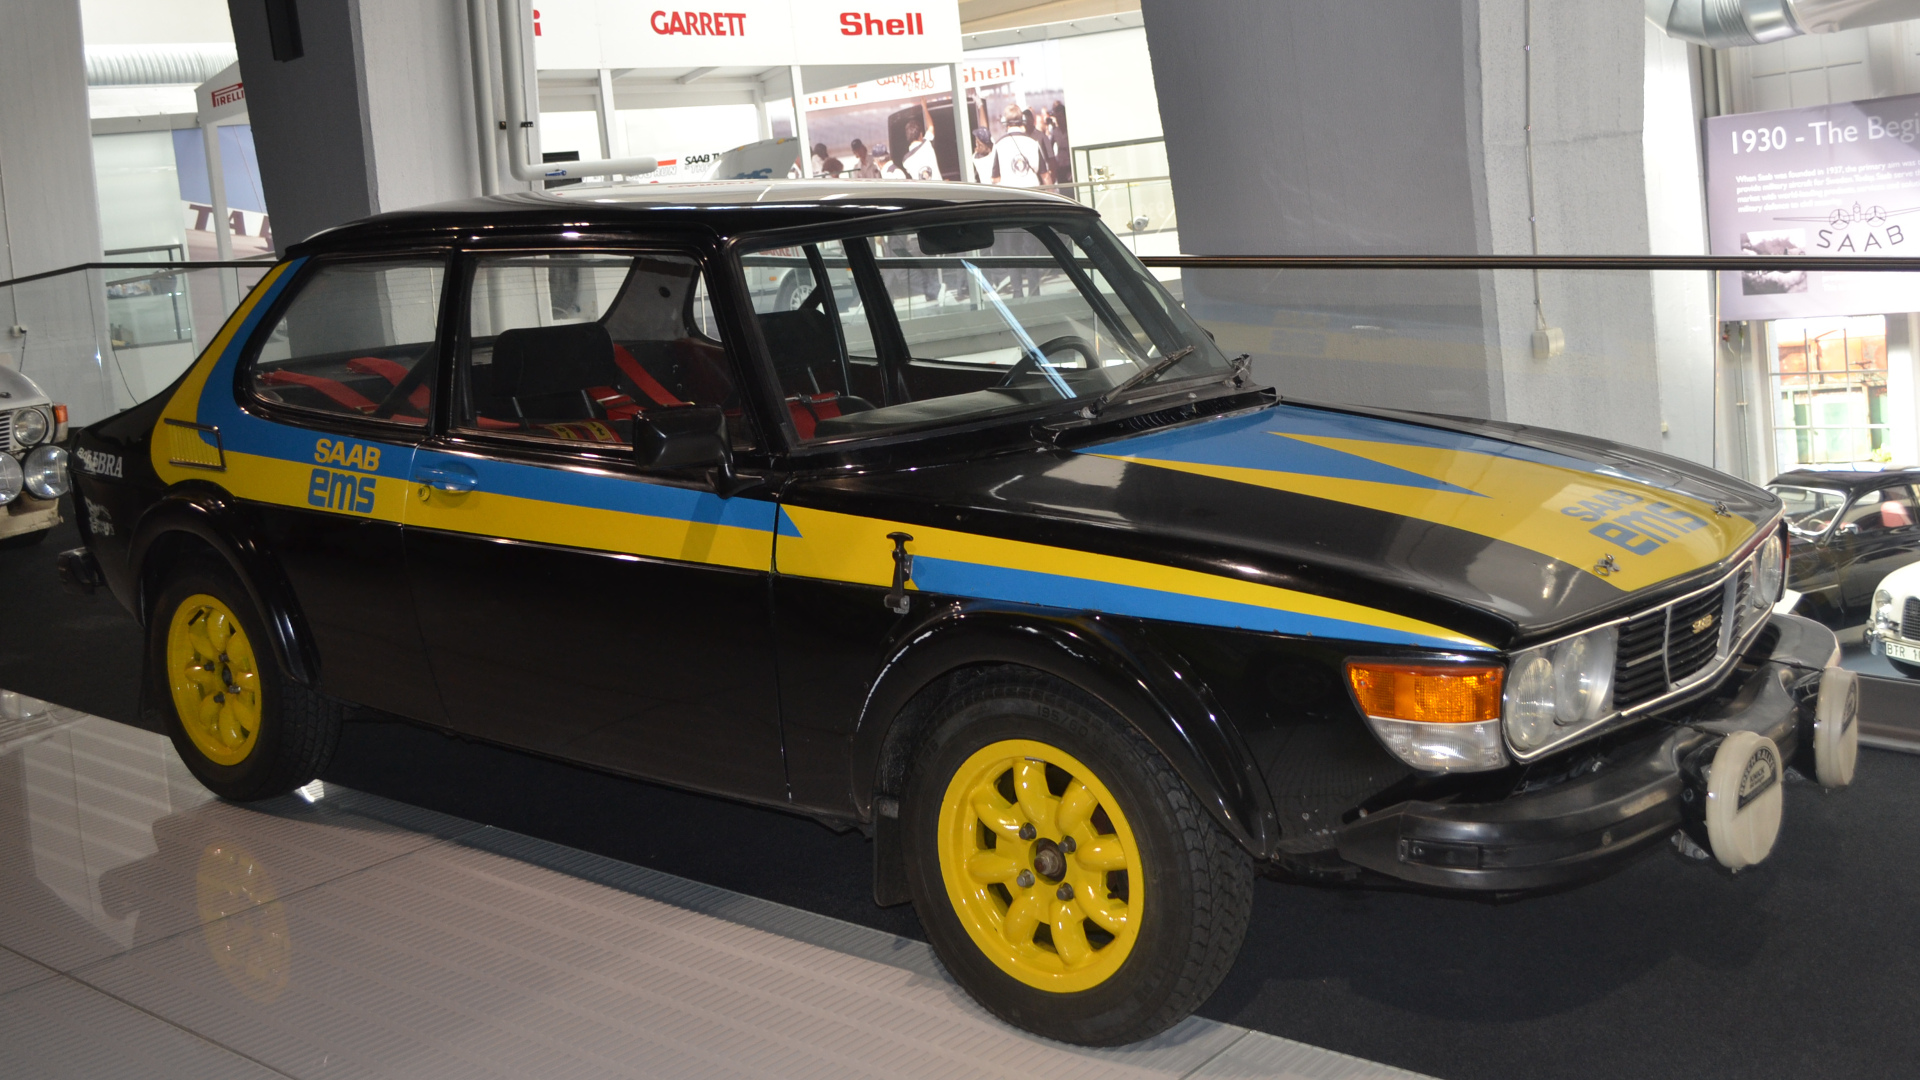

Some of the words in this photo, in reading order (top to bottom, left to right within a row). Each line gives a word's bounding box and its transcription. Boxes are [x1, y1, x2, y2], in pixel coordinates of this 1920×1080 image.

[650, 10, 747, 36] GARRETT
[839, 12, 924, 36] Shell
[211, 82, 245, 108] PIRELLI
[1731, 126, 1787, 154] 1930
[1808, 120, 1858, 146] The
[685, 154, 710, 165] SAAB
[1788, 169, 1816, 178] founded
[1857, 163, 1886, 173] primary
[1816, 224, 1904, 252] SAAB
[314, 438, 381, 471] SAAB
[308, 468, 377, 514] ems
[1560, 488, 1644, 522] SAAB
[1588, 501, 1710, 556] ems
[1887, 643, 1905, 658] BTR
